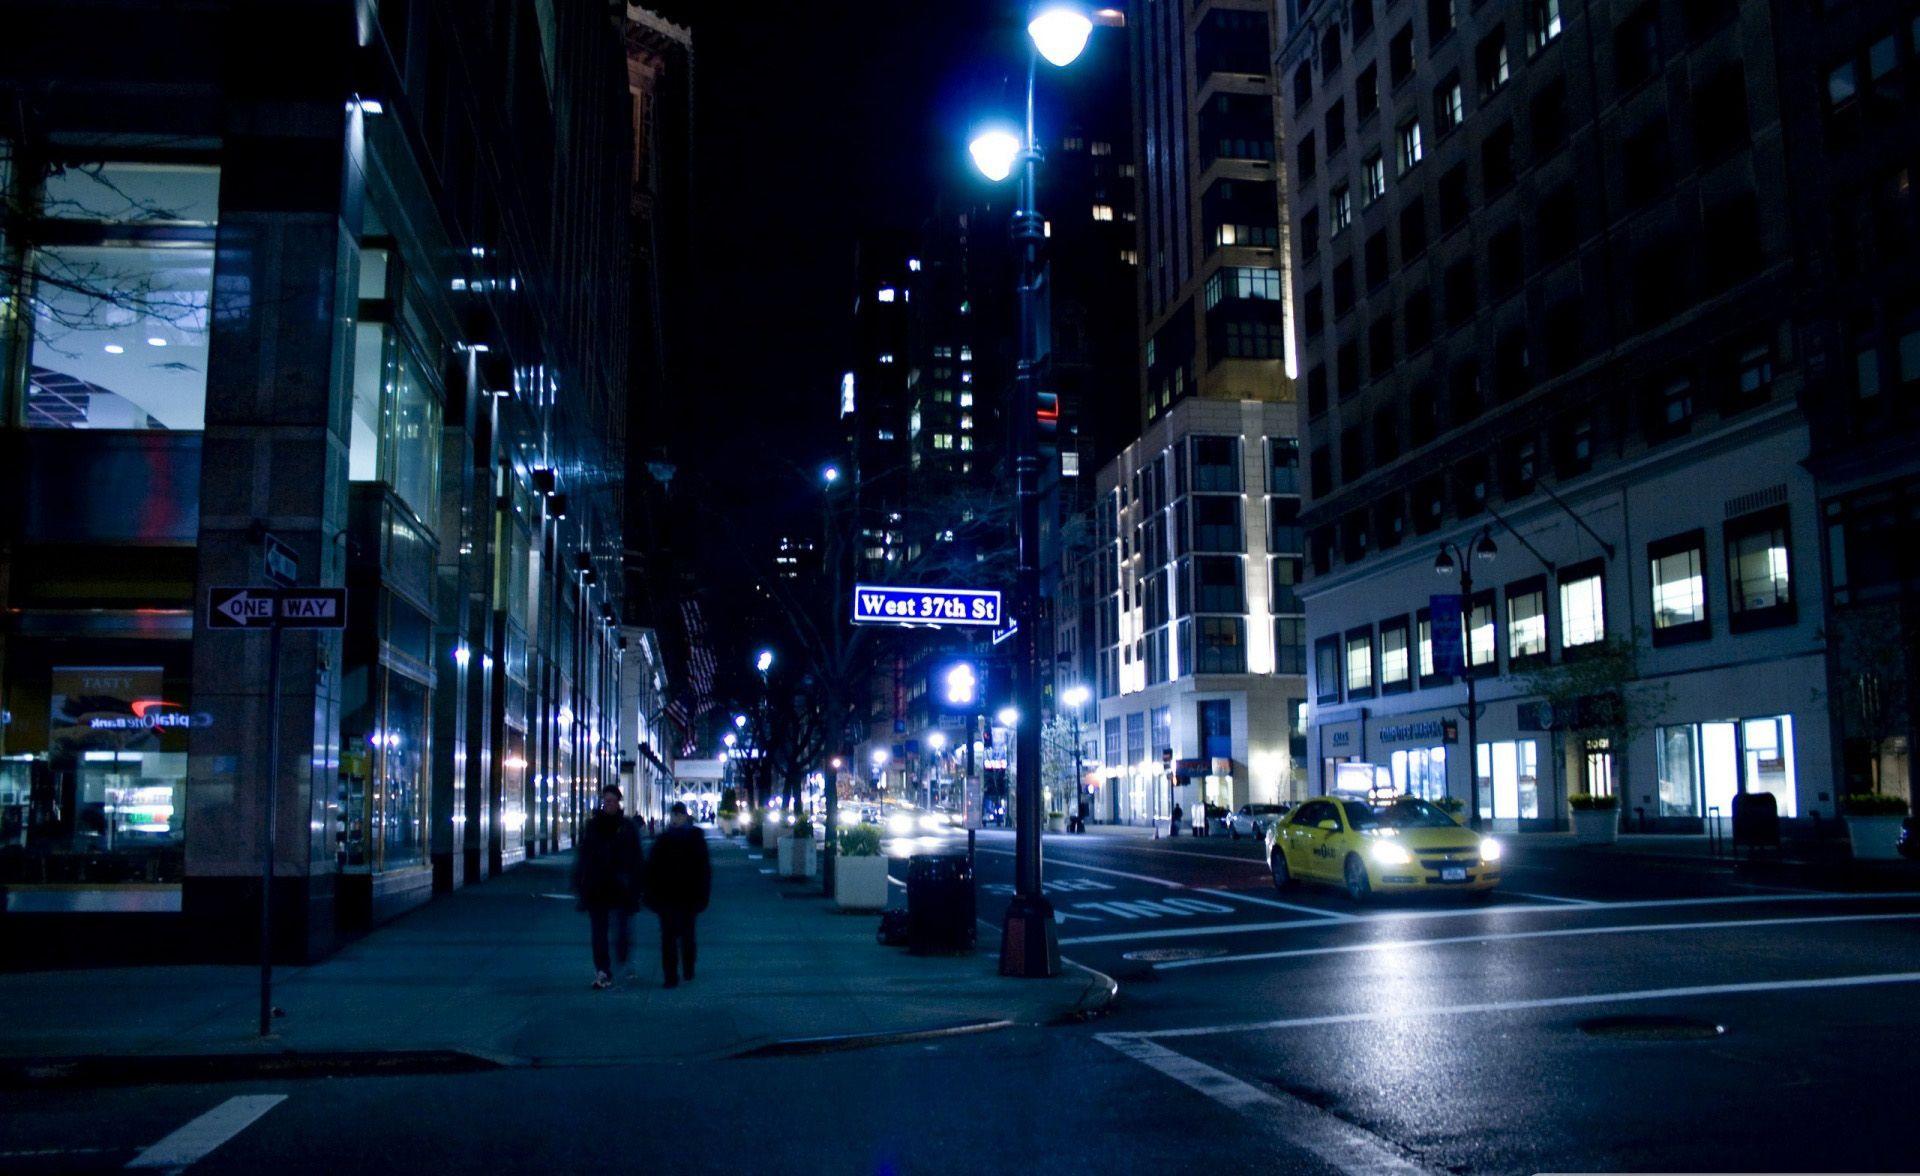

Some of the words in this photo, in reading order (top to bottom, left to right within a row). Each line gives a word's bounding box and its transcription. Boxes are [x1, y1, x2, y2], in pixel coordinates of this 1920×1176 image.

[230, 600, 268, 616] ONE
[287, 600, 328, 616] WAY
[861, 594, 916, 617] West
[920, 596, 967, 618] 37th
[971, 598, 995, 619] St
